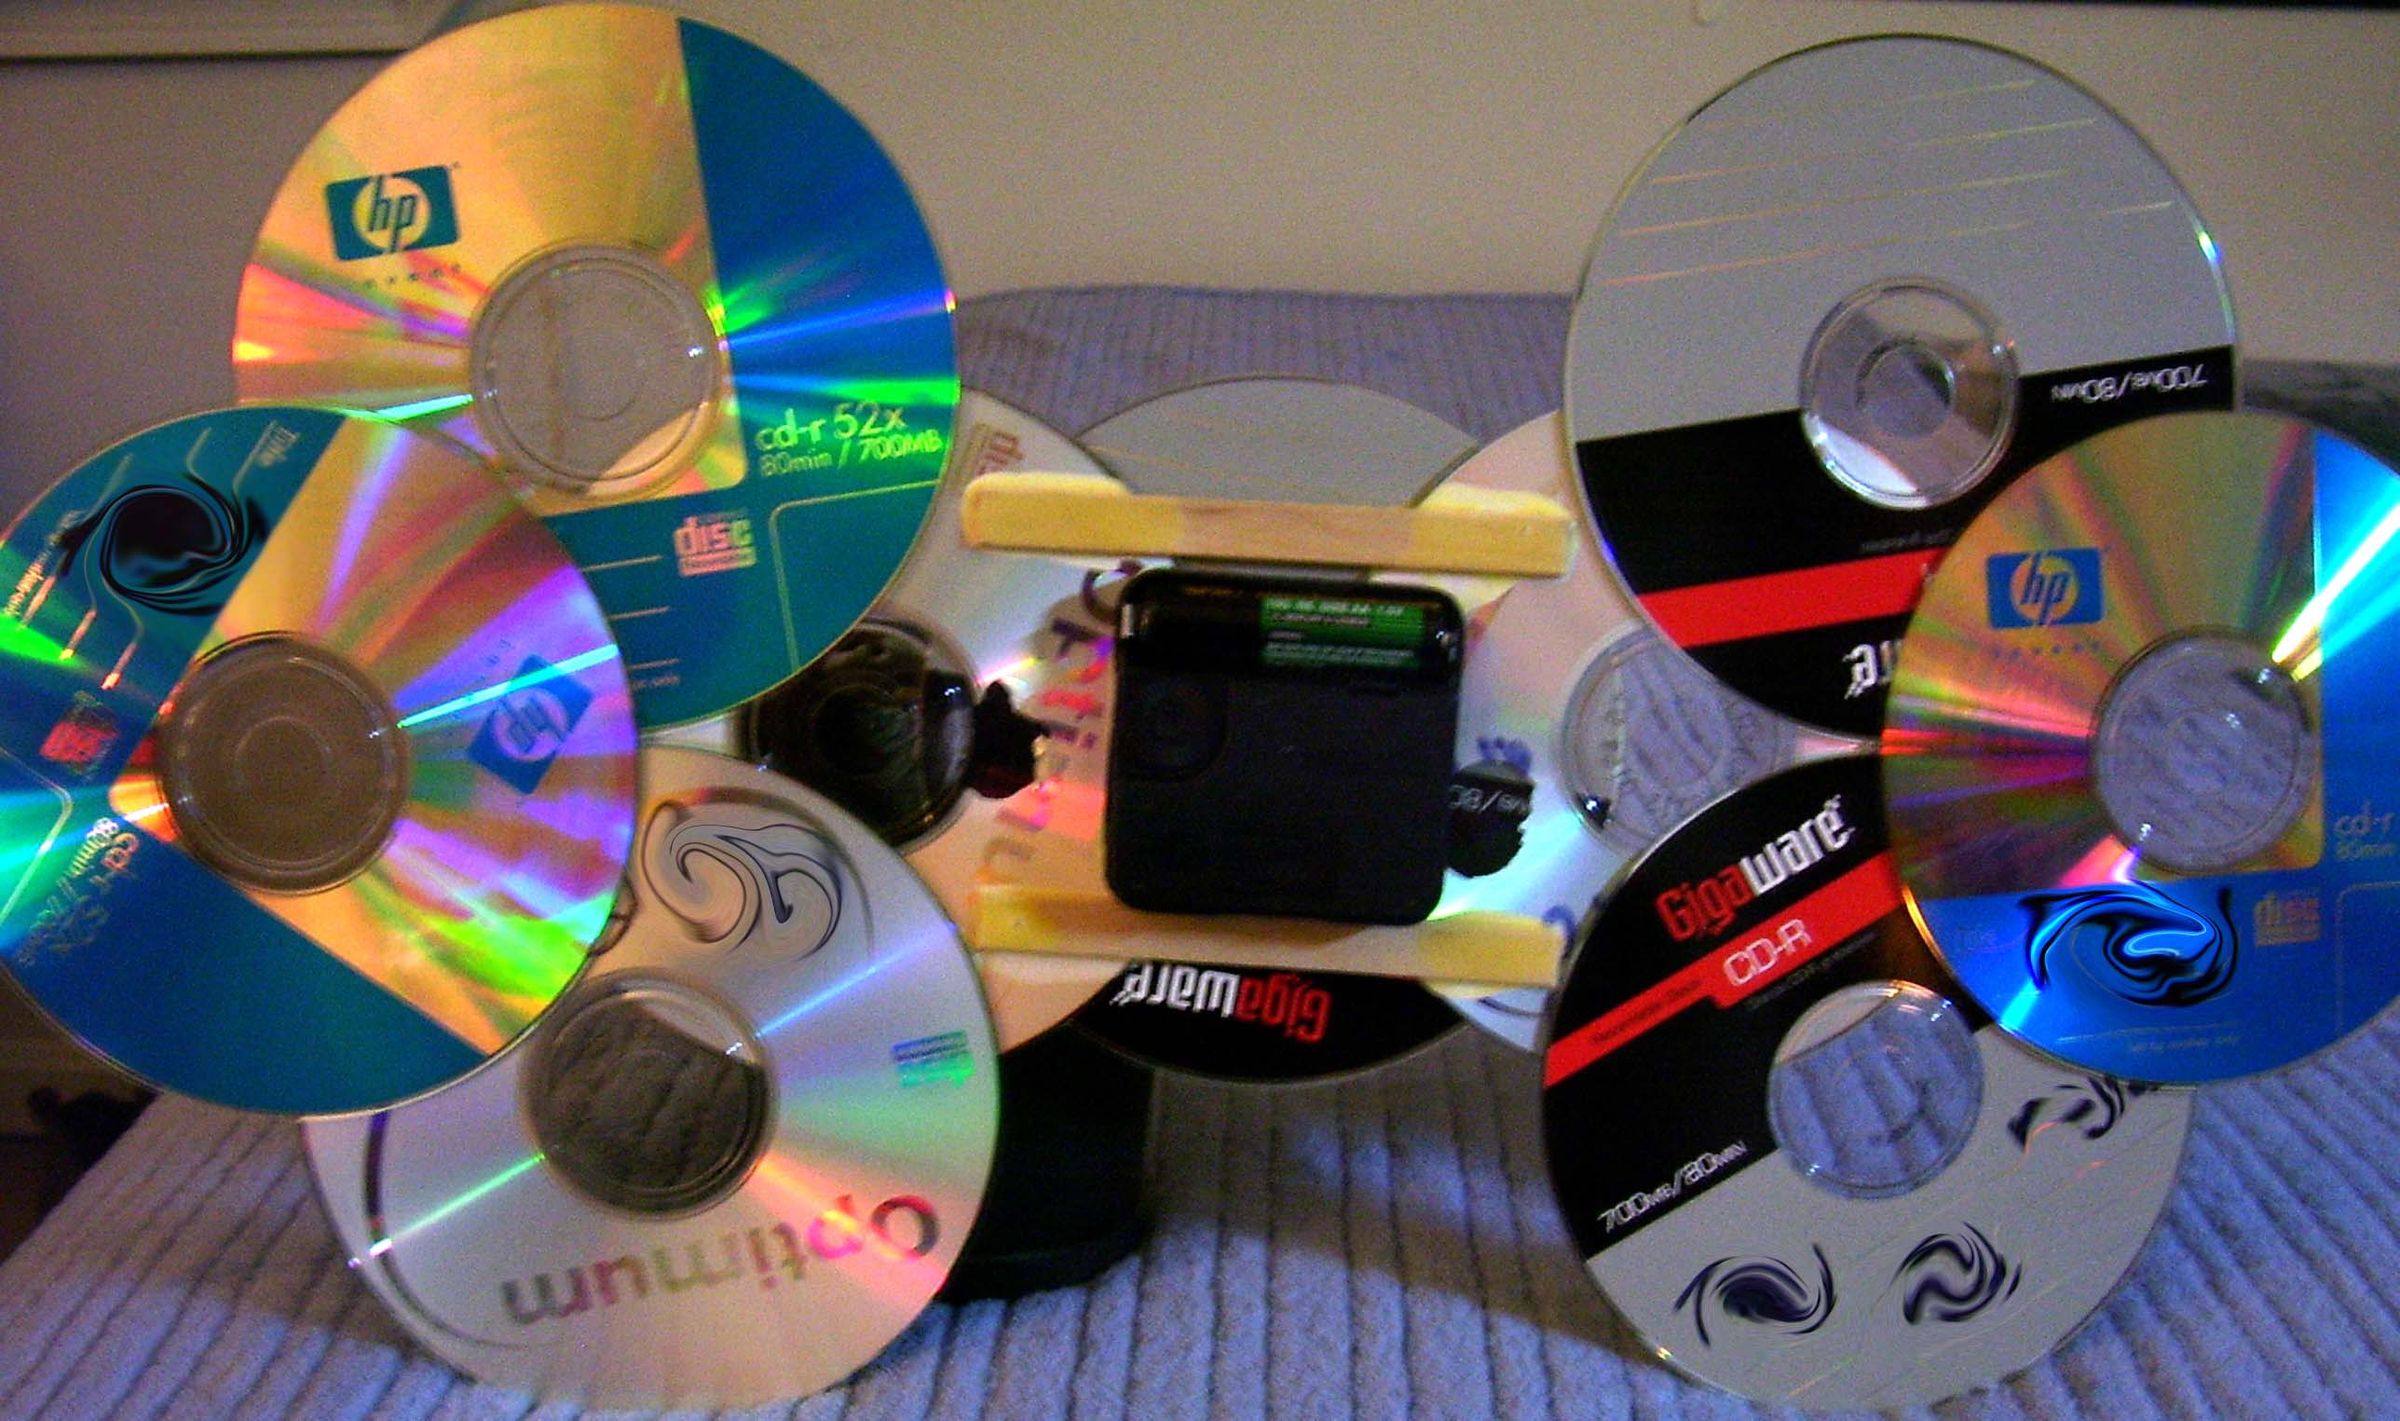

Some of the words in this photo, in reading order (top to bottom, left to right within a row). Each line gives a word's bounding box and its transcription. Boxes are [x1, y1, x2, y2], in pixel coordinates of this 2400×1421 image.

[756, 408, 827, 451] cd-r
[833, 402, 907, 441] 52x
[1655, 806, 1856, 943] Gigaware
[1722, 917, 1813, 987] CD-R
[1108, 963, 1333, 1044] Gigaware
